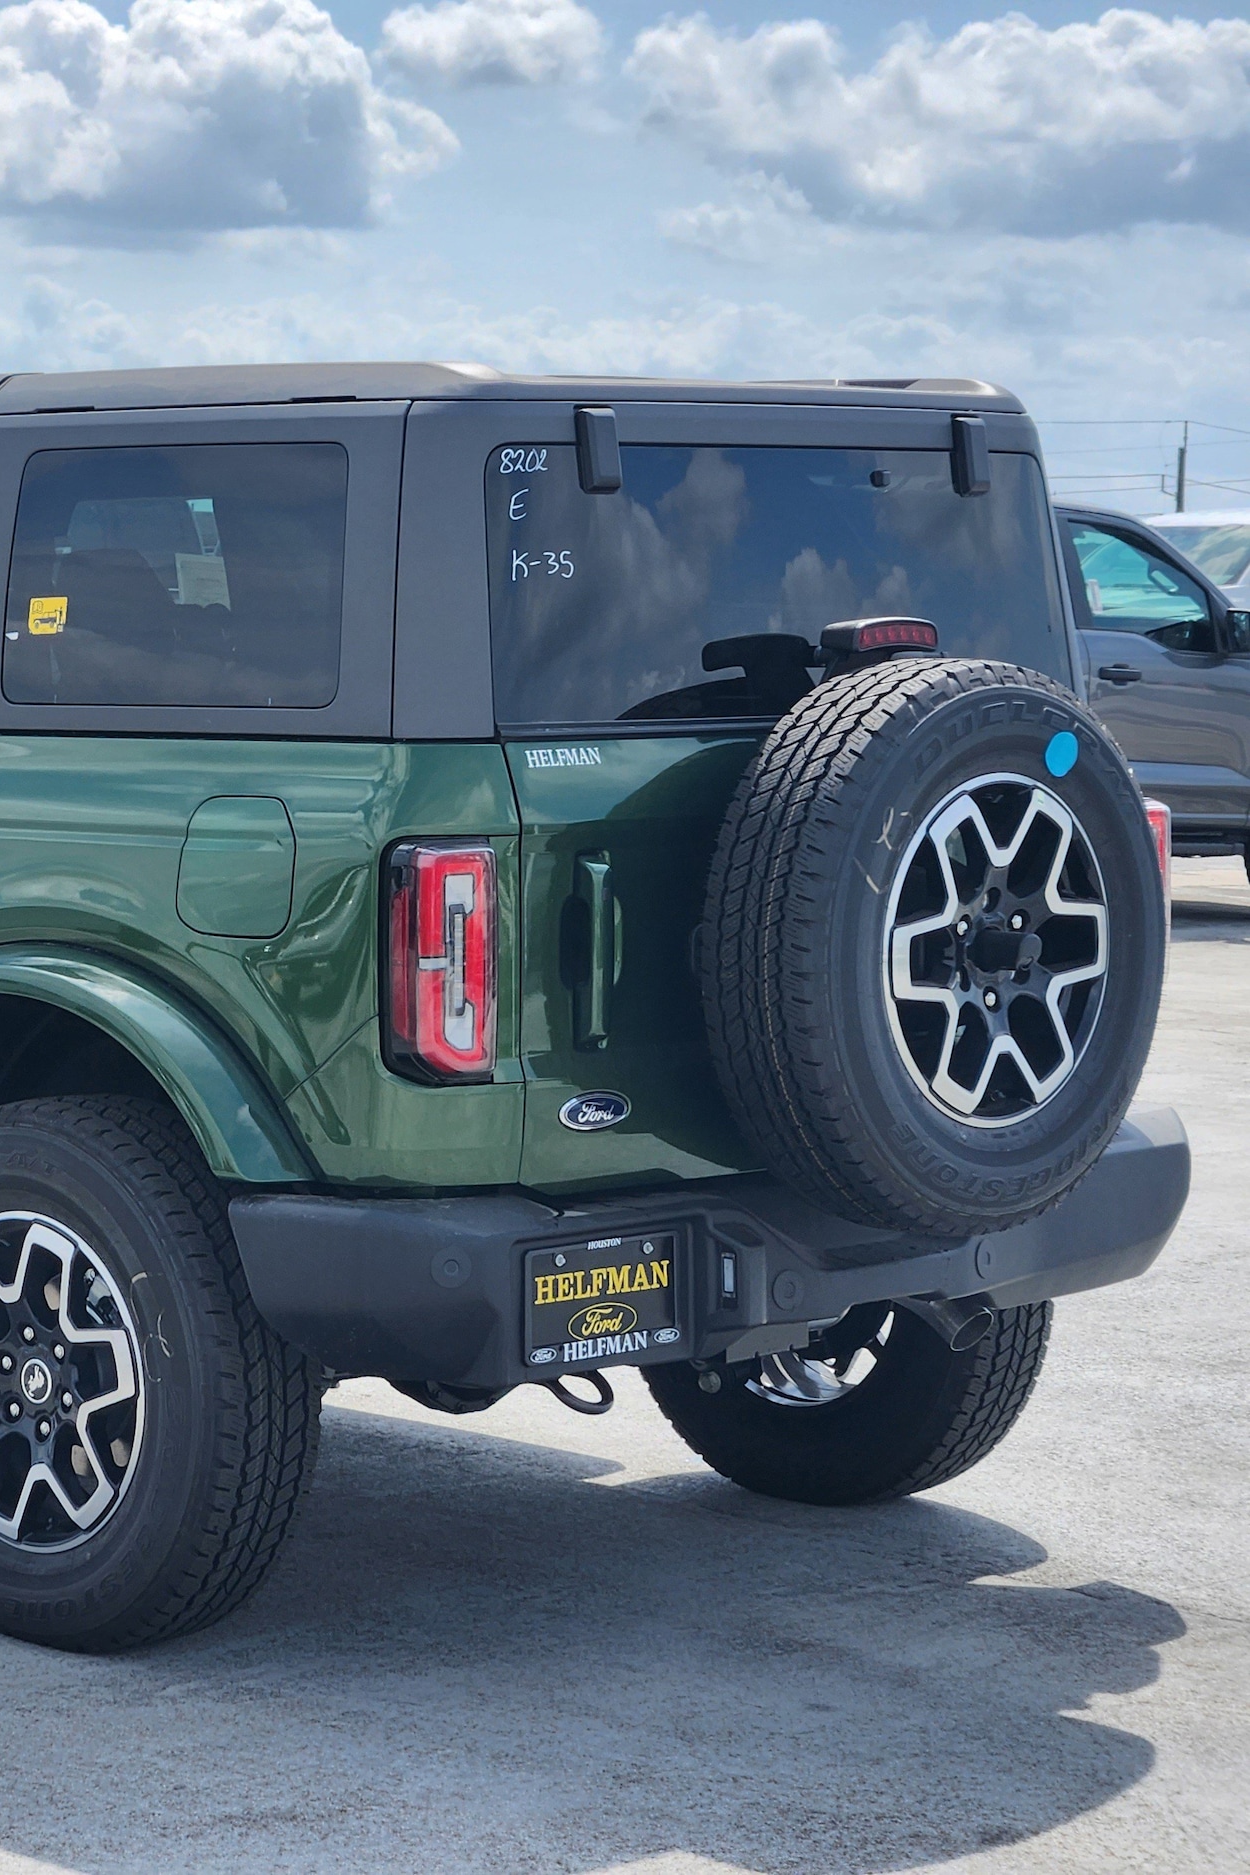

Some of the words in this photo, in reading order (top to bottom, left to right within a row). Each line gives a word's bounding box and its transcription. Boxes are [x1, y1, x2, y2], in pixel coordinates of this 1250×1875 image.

[499, 448, 549, 474] 8202
[509, 488, 529, 520] E
[511, 549, 575, 581] K-35
[524, 747, 602, 768] HELFMAN
[577, 1100, 616, 1123] Ford
[587, 1237, 622, 1250] HOUSTON
[534, 1259, 670, 1305] HELFMAN
[581, 1307, 624, 1336] Ford
[563, 1331, 649, 1362] HELFMAN
